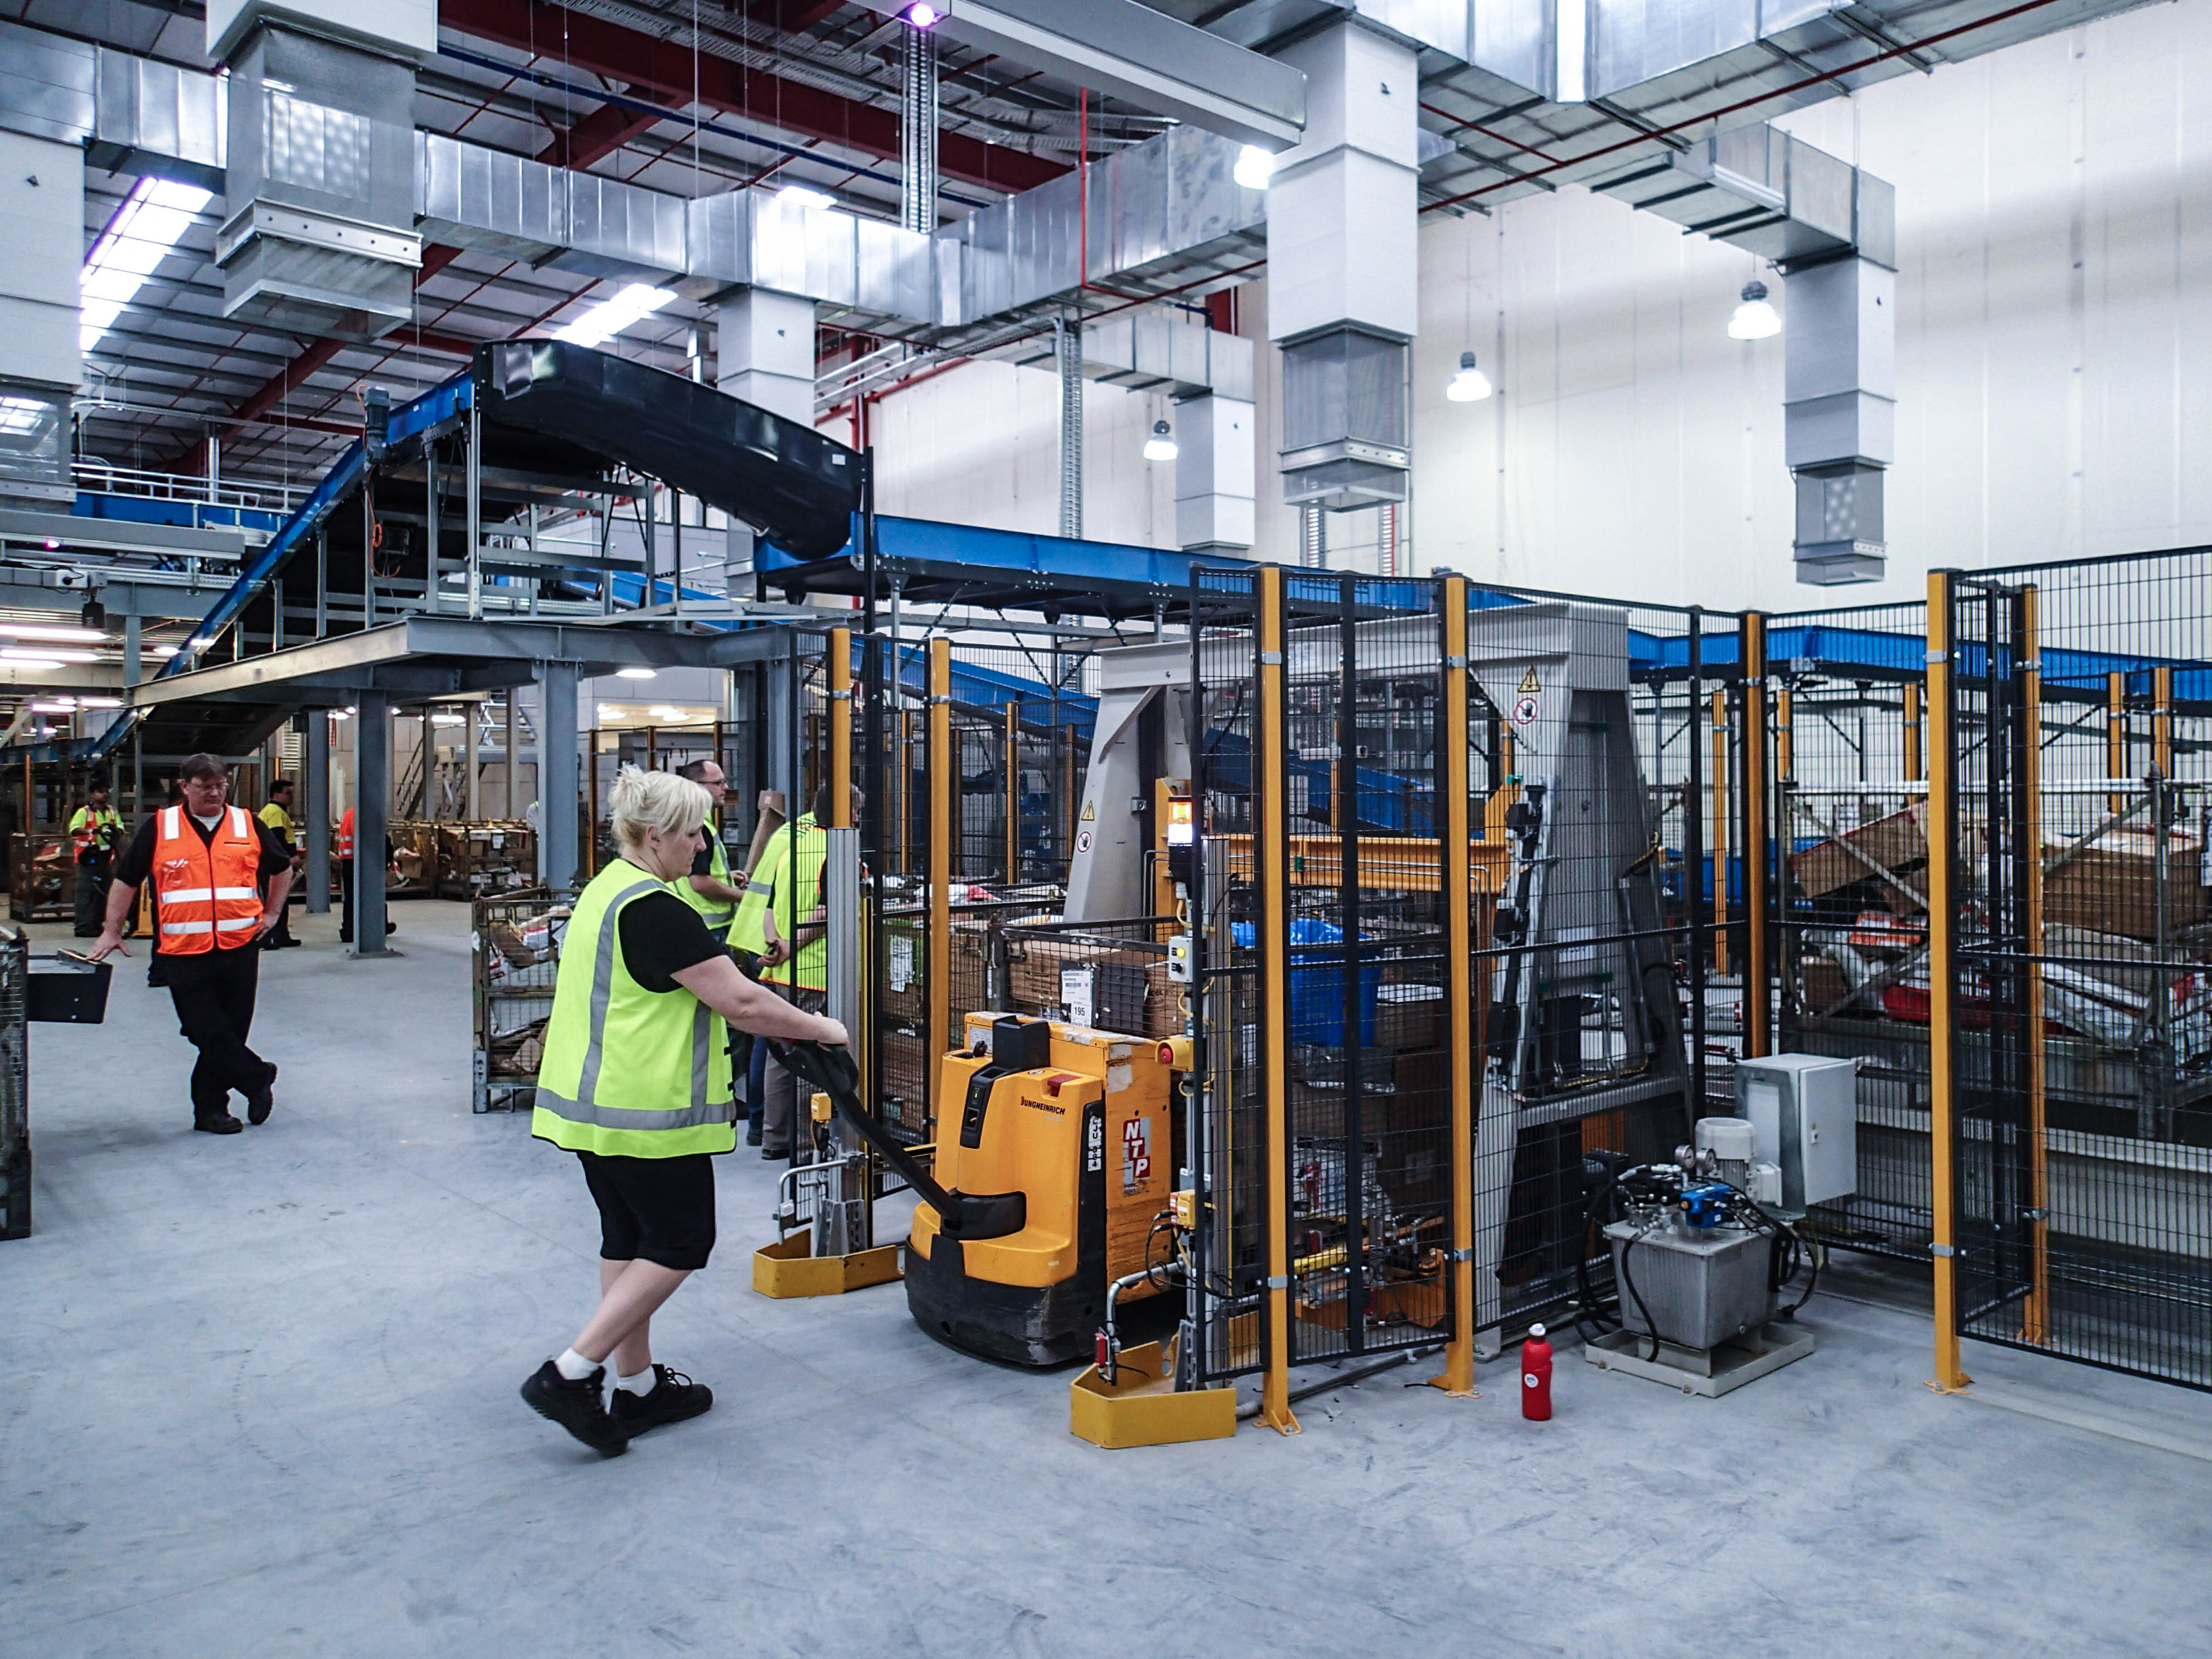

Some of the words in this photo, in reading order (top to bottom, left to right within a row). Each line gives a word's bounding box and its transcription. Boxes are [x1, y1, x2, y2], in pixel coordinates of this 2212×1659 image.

[1074, 1006, 1085, 1016] 195
[1020, 1096, 1066, 1115] JUNGHEINRICH
[1125, 1121, 1148, 1177] NTP
